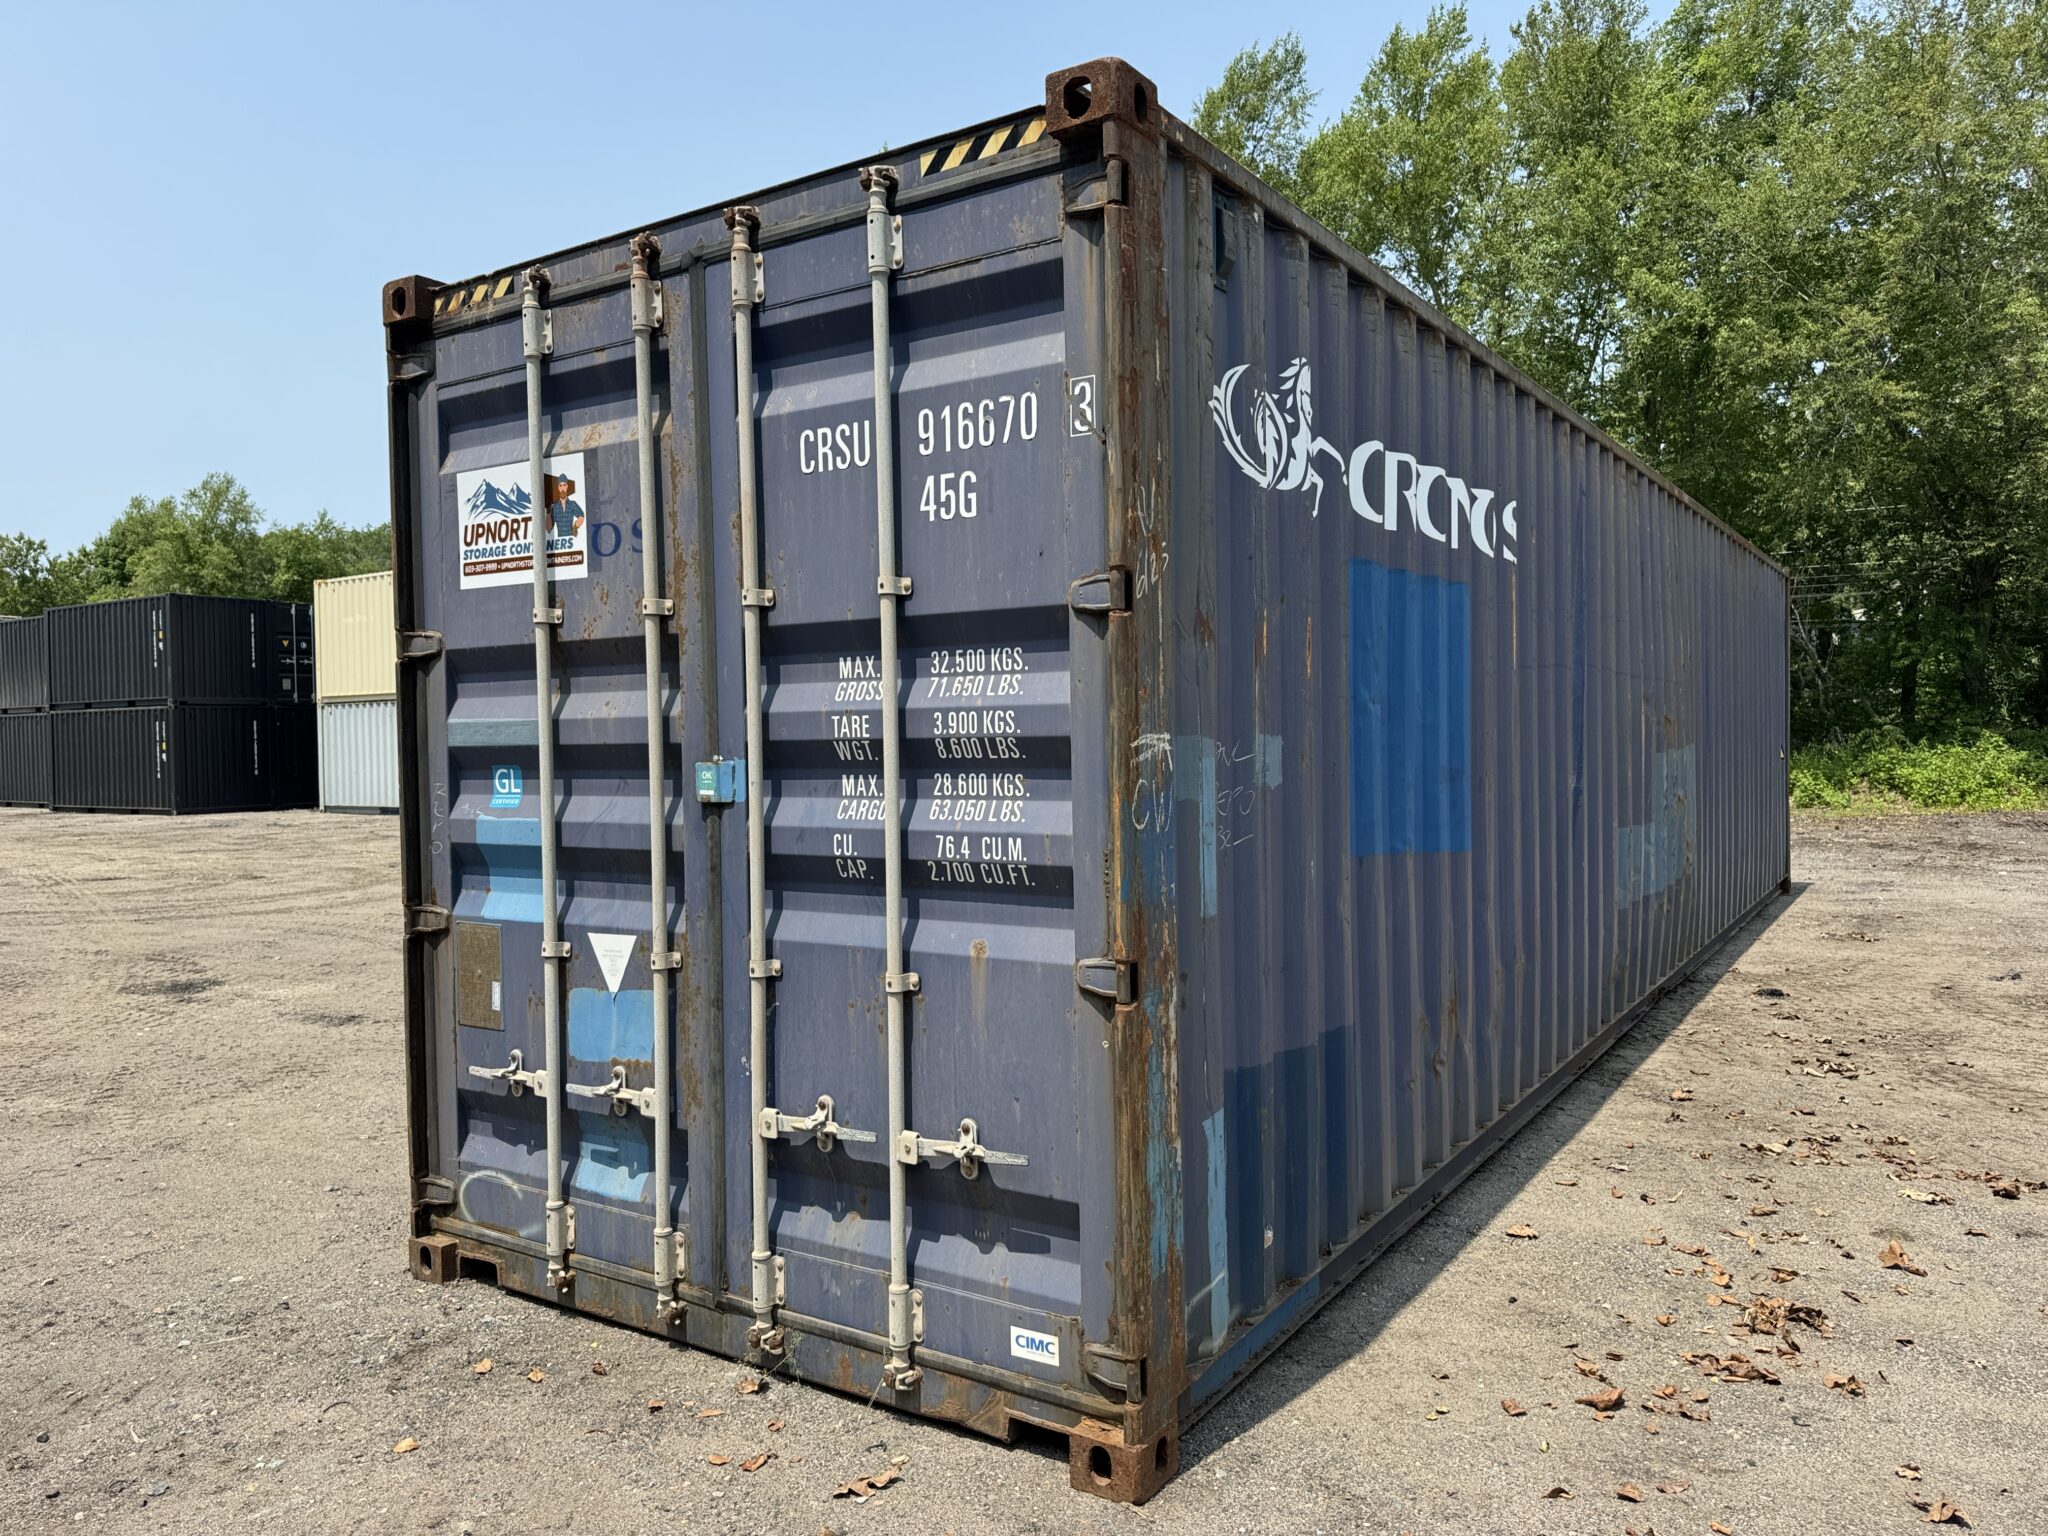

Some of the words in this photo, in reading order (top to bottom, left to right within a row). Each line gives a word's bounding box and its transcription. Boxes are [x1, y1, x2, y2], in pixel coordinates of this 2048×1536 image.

[799, 420, 871, 475] CRSU
[917, 391, 1038, 457] 916670
[1073, 380, 1092, 433] 3
[919, 470, 977, 522] 45G
[463, 516, 533, 547] UPNORT
[463, 545, 507, 561] STORAGE
[509, 537, 574, 556] CONNERS
[838, 655, 881, 679] MAX.
[930, 648, 985, 674] 32,500
[991, 647, 1029, 672] KGS.
[834, 680, 884, 701] GROSS
[927, 675, 985, 698] 71,650
[986, 674, 1025, 696] LBS.
[831, 714, 870, 738] TARE
[933, 711, 978, 735] 3,900
[983, 710, 1021, 734] KGS.
[833, 740, 879, 761] WGT.
[984, 736, 1027, 759] LBS.
[495, 768, 521, 793] GL
[701, 771, 713, 780] OK
[841, 774, 883, 797] MAX.
[933, 773, 988, 796] 28,600
[992, 773, 1031, 797] KGS.
[836, 799, 886, 820] CARGO
[929, 799, 987, 821] 63,050
[987, 799, 1026, 822] LBS.
[833, 833, 858, 856] CU.
[935, 834, 971, 860] 76.4
[981, 836, 1028, 861] CU.M.
[835, 858, 875, 879] CAP.
[980, 862, 1036, 886] CU.FT.
[1015, 1334, 1056, 1356] CIMC
